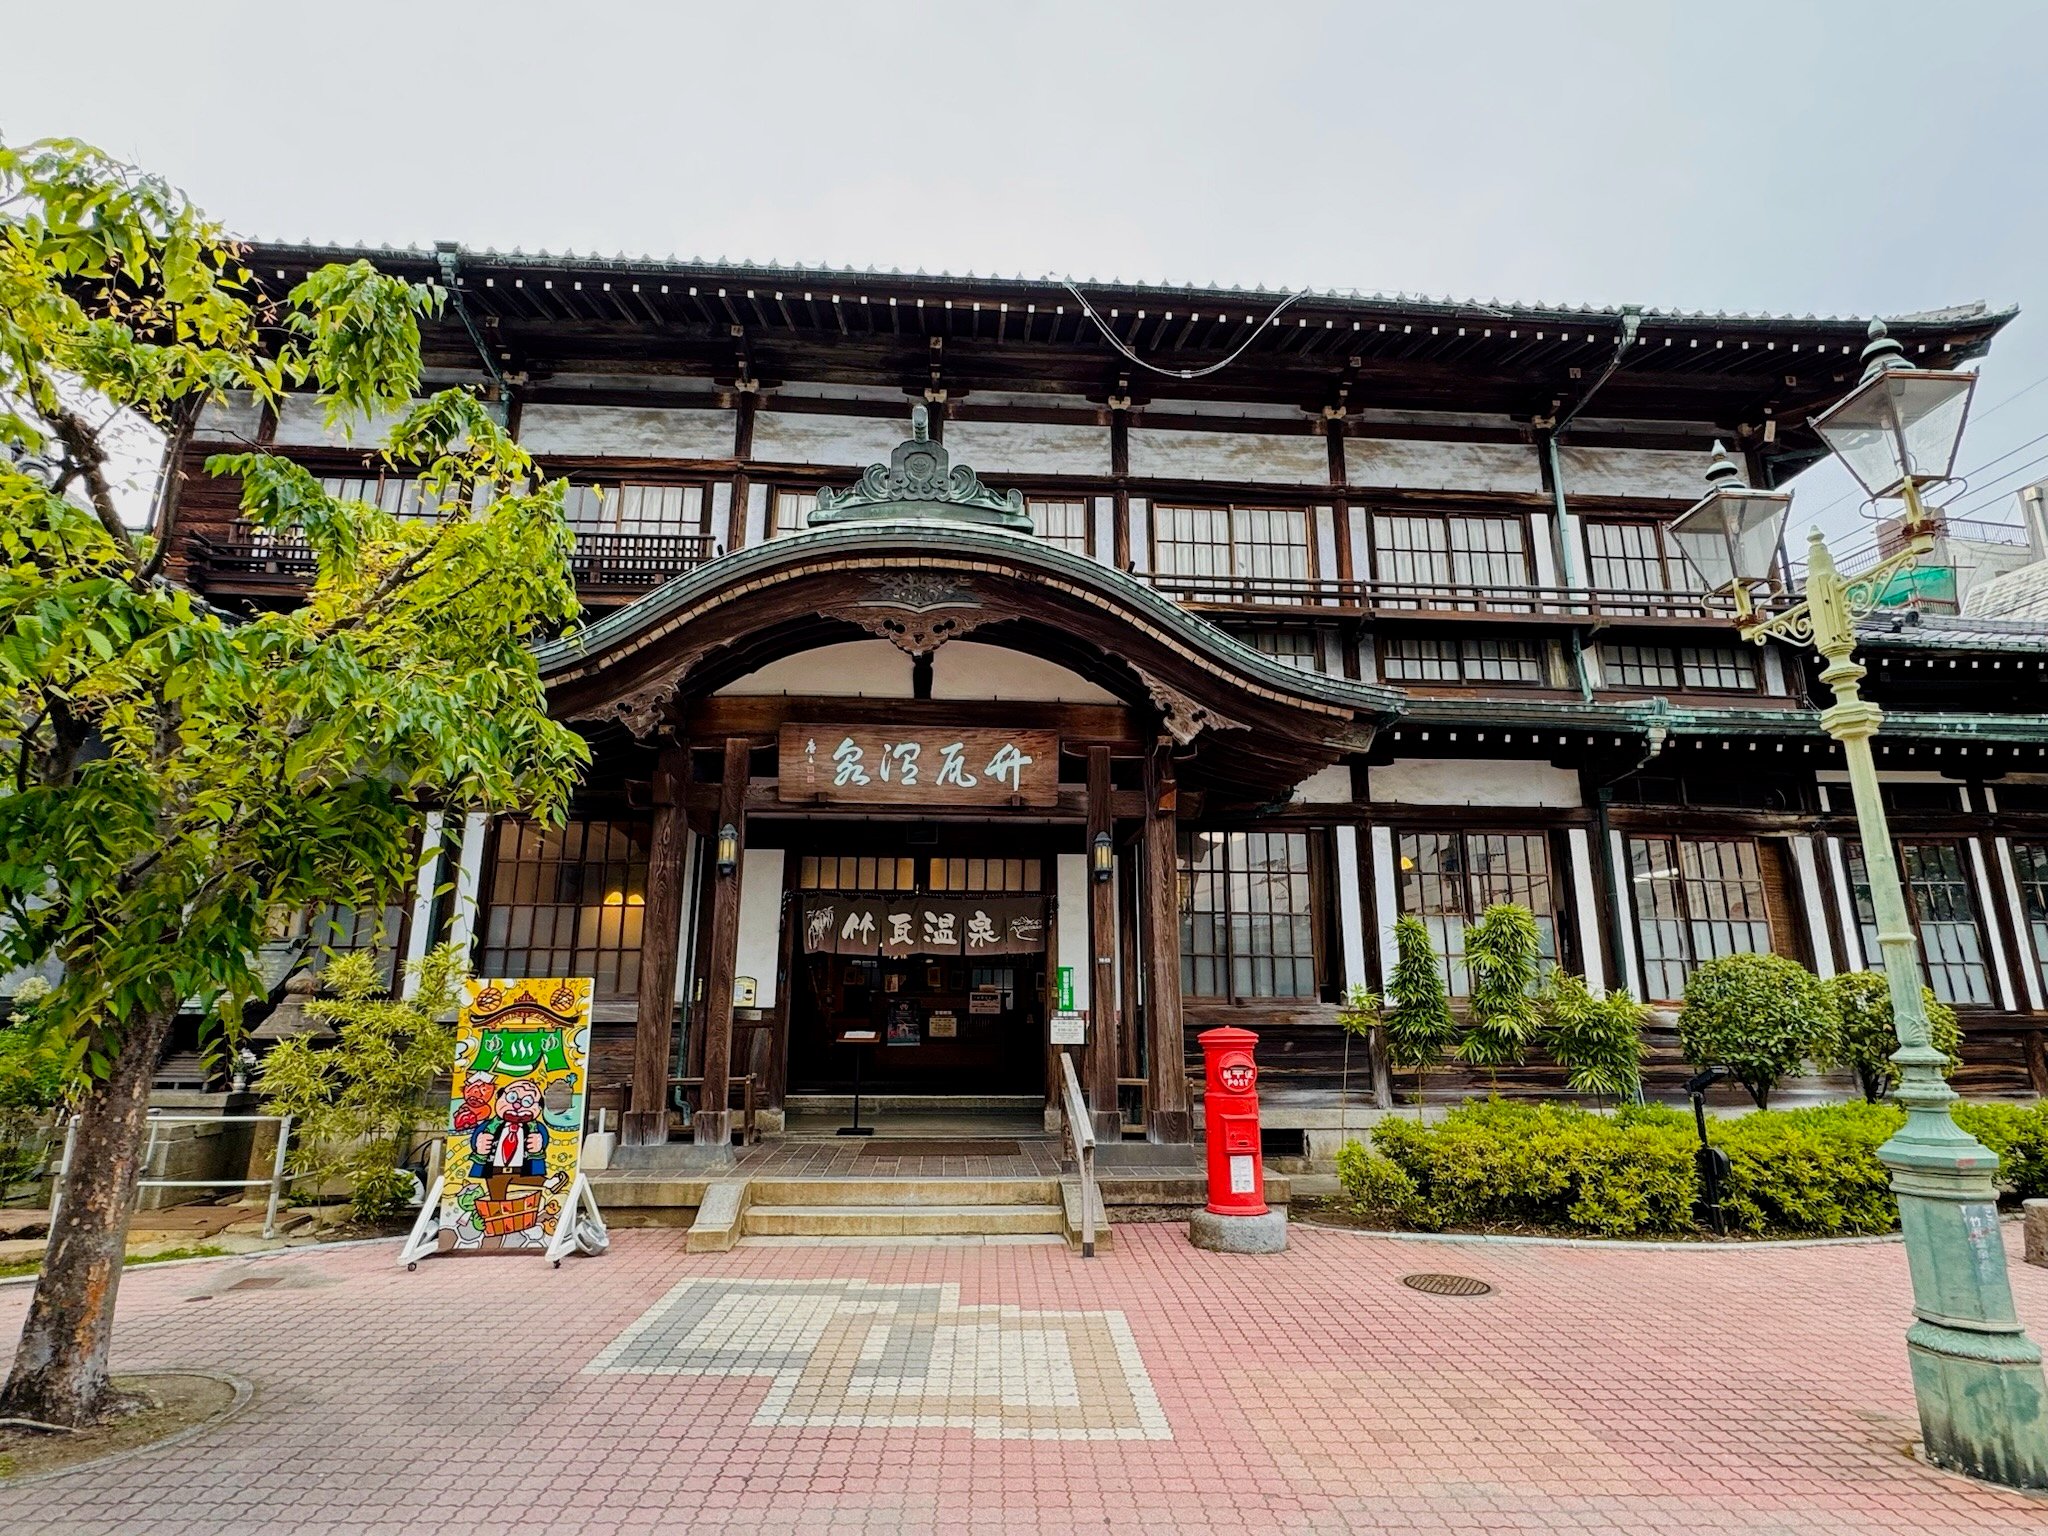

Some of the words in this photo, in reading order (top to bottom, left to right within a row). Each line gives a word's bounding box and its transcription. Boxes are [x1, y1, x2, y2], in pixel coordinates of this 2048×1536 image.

[841, 910, 1001, 948] 竹瓦温泉
[1227, 1078, 1249, 1087] POST
